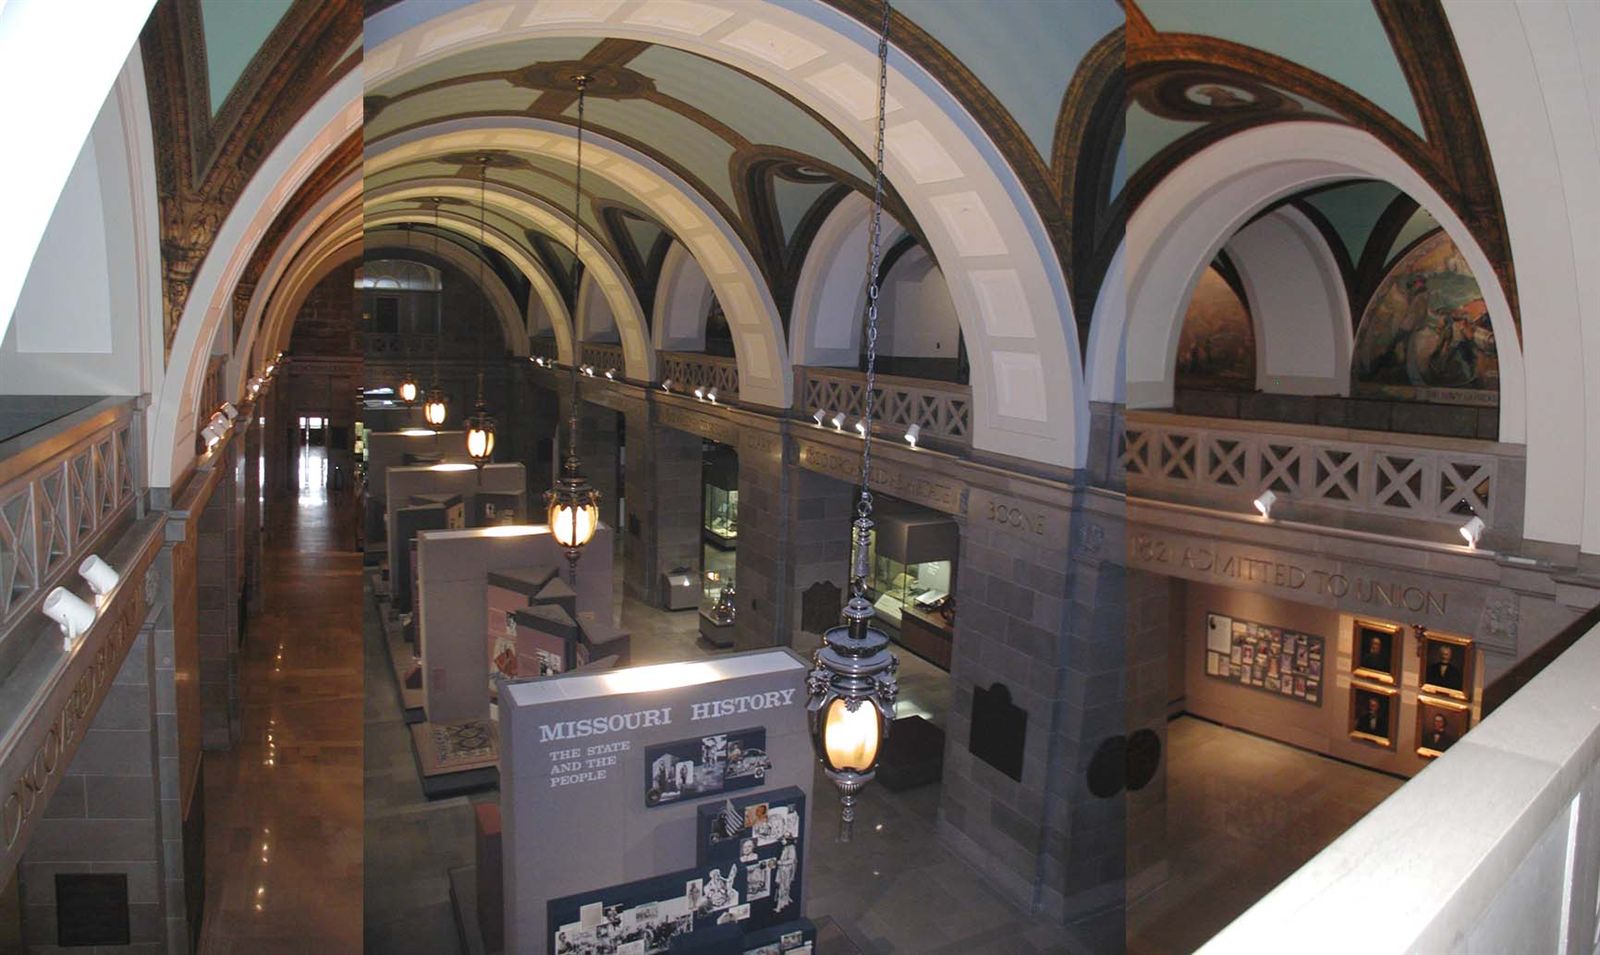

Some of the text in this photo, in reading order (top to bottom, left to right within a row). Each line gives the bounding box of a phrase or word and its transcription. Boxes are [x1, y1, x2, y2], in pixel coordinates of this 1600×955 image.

[985, 500, 1048, 536] BOONE
[1180, 547, 1308, 590] ADMITTED
[1312, 570, 1350, 598] TO
[1356, 579, 1448, 616] UNION
[539, 688, 796, 743] MISSOURI HISTORY
[549, 740, 631, 762] THE STATE
[550, 755, 617, 774] AND THE
[550, 770, 607, 788] PEOPLE
